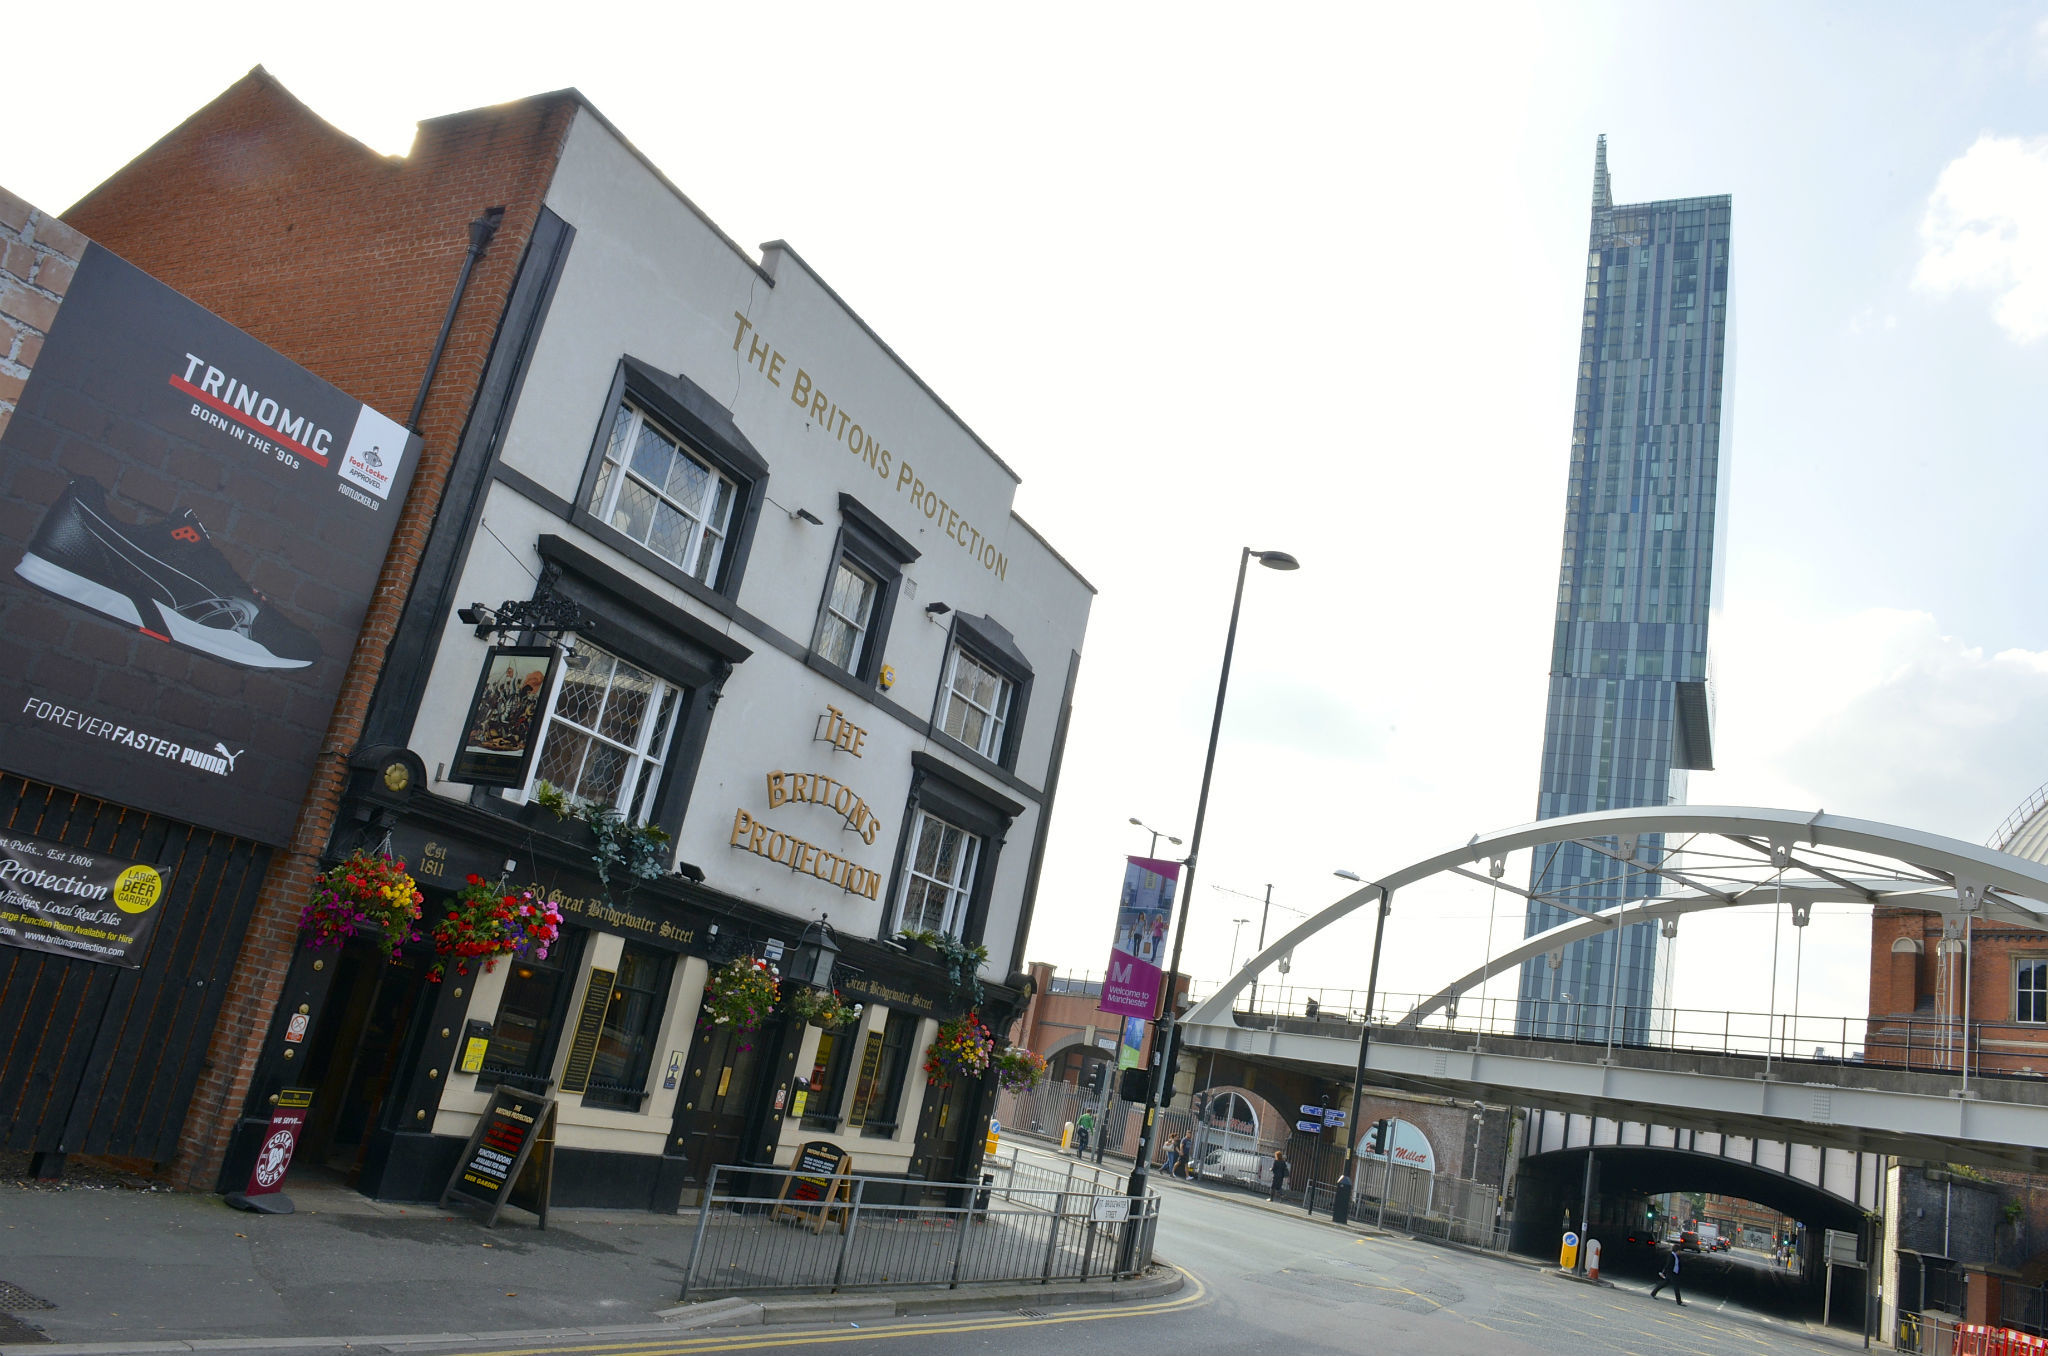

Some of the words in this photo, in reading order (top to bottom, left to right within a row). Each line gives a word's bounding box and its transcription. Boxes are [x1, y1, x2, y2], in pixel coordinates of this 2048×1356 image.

[184, 353, 333, 456] TRINOMIC
[190, 403, 228, 432] BORN
[229, 424, 245, 440] IN
[247, 433, 271, 455] THE
[733, 310, 786, 388] THE
[791, 368, 891, 479] BRITONS
[896, 461, 1008, 582] PROTECTION
[349, 456, 365, 470] Foot
[365, 465, 388, 482] Locker
[338, 483, 380, 511] FOOTLOCKER.EU
[824, 704, 868, 758] THE
[180, 747, 228, 776] PUMA
[766, 769, 881, 845] BRITONS
[10, 839, 43, 857] Pubs...
[47, 849, 66, 861] Est
[67, 854, 94, 868] 1806
[424, 841, 447, 860] Est
[730, 808, 882, 901] PROTECTION
[0, 859, 108, 901] Protection
[127, 870, 158, 883] LARGE
[419, 858, 444, 877] 1811
[117, 893, 151, 906] GARDEN
[121, 879, 156, 897] BEER
[42, 901, 75, 917] Local
[74, 906, 101, 923] Real
[98, 912, 121, 926] Ales
[547, 888, 585, 912] Great
[585, 896, 656, 936] Bridgewater
[659, 921, 695, 944] Street
[0, 911, 19, 922] arge
[19, 914, 53, 929] Function
[53, 921, 74, 933] Room
[74, 926, 106, 939] Available
[107, 931, 117, 941] for
[117, 932, 134, 944] Hire
[24, 930, 125, 957] www.britonsprotection.com
[1112, 961, 1133, 985] M
[869, 979, 911, 1004] Bridgewater
[912, 992, 934, 1010] Street
[1107, 993, 1148, 1008] Manchester
[1109, 985, 1141, 999] Welcome
[1141, 991, 1149, 999] to
[268, 1132, 292, 1149] COSTA
[258, 1164, 285, 1184] COFFEE
[464, 1173, 476, 1183] BEER
[476, 1178, 499, 1190] GARDEN
